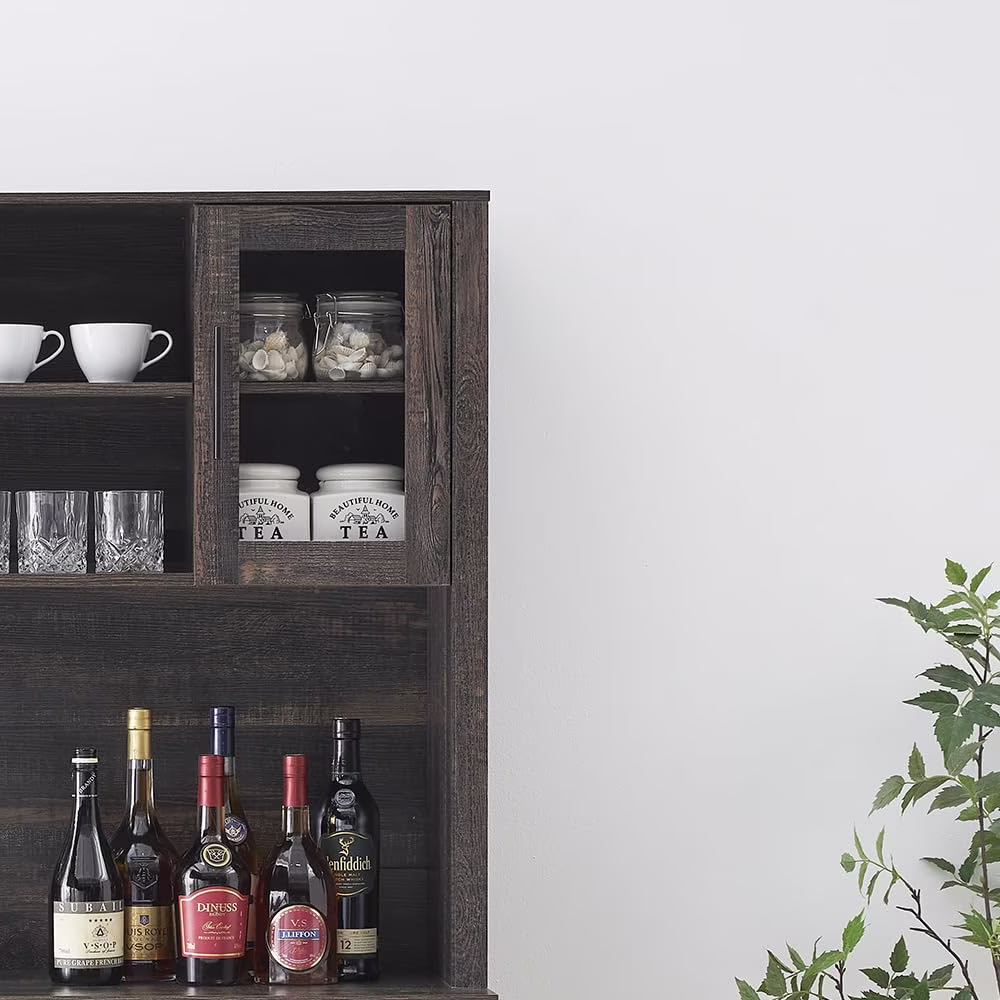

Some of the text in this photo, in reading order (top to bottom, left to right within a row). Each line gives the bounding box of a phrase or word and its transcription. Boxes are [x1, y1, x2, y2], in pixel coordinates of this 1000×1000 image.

[239, 497, 295, 520] UTIFUL HOME
[329, 497, 400, 520] BEAUTIFUL HOME
[239, 526, 283, 540] TEA
[340, 526, 388, 539] TEA
[327, 855, 371, 871] enfiddich
[127, 928, 168, 936] UIS ROYE
[340, 940, 351, 950] 12
[71, 959, 95, 968] GRAPE
